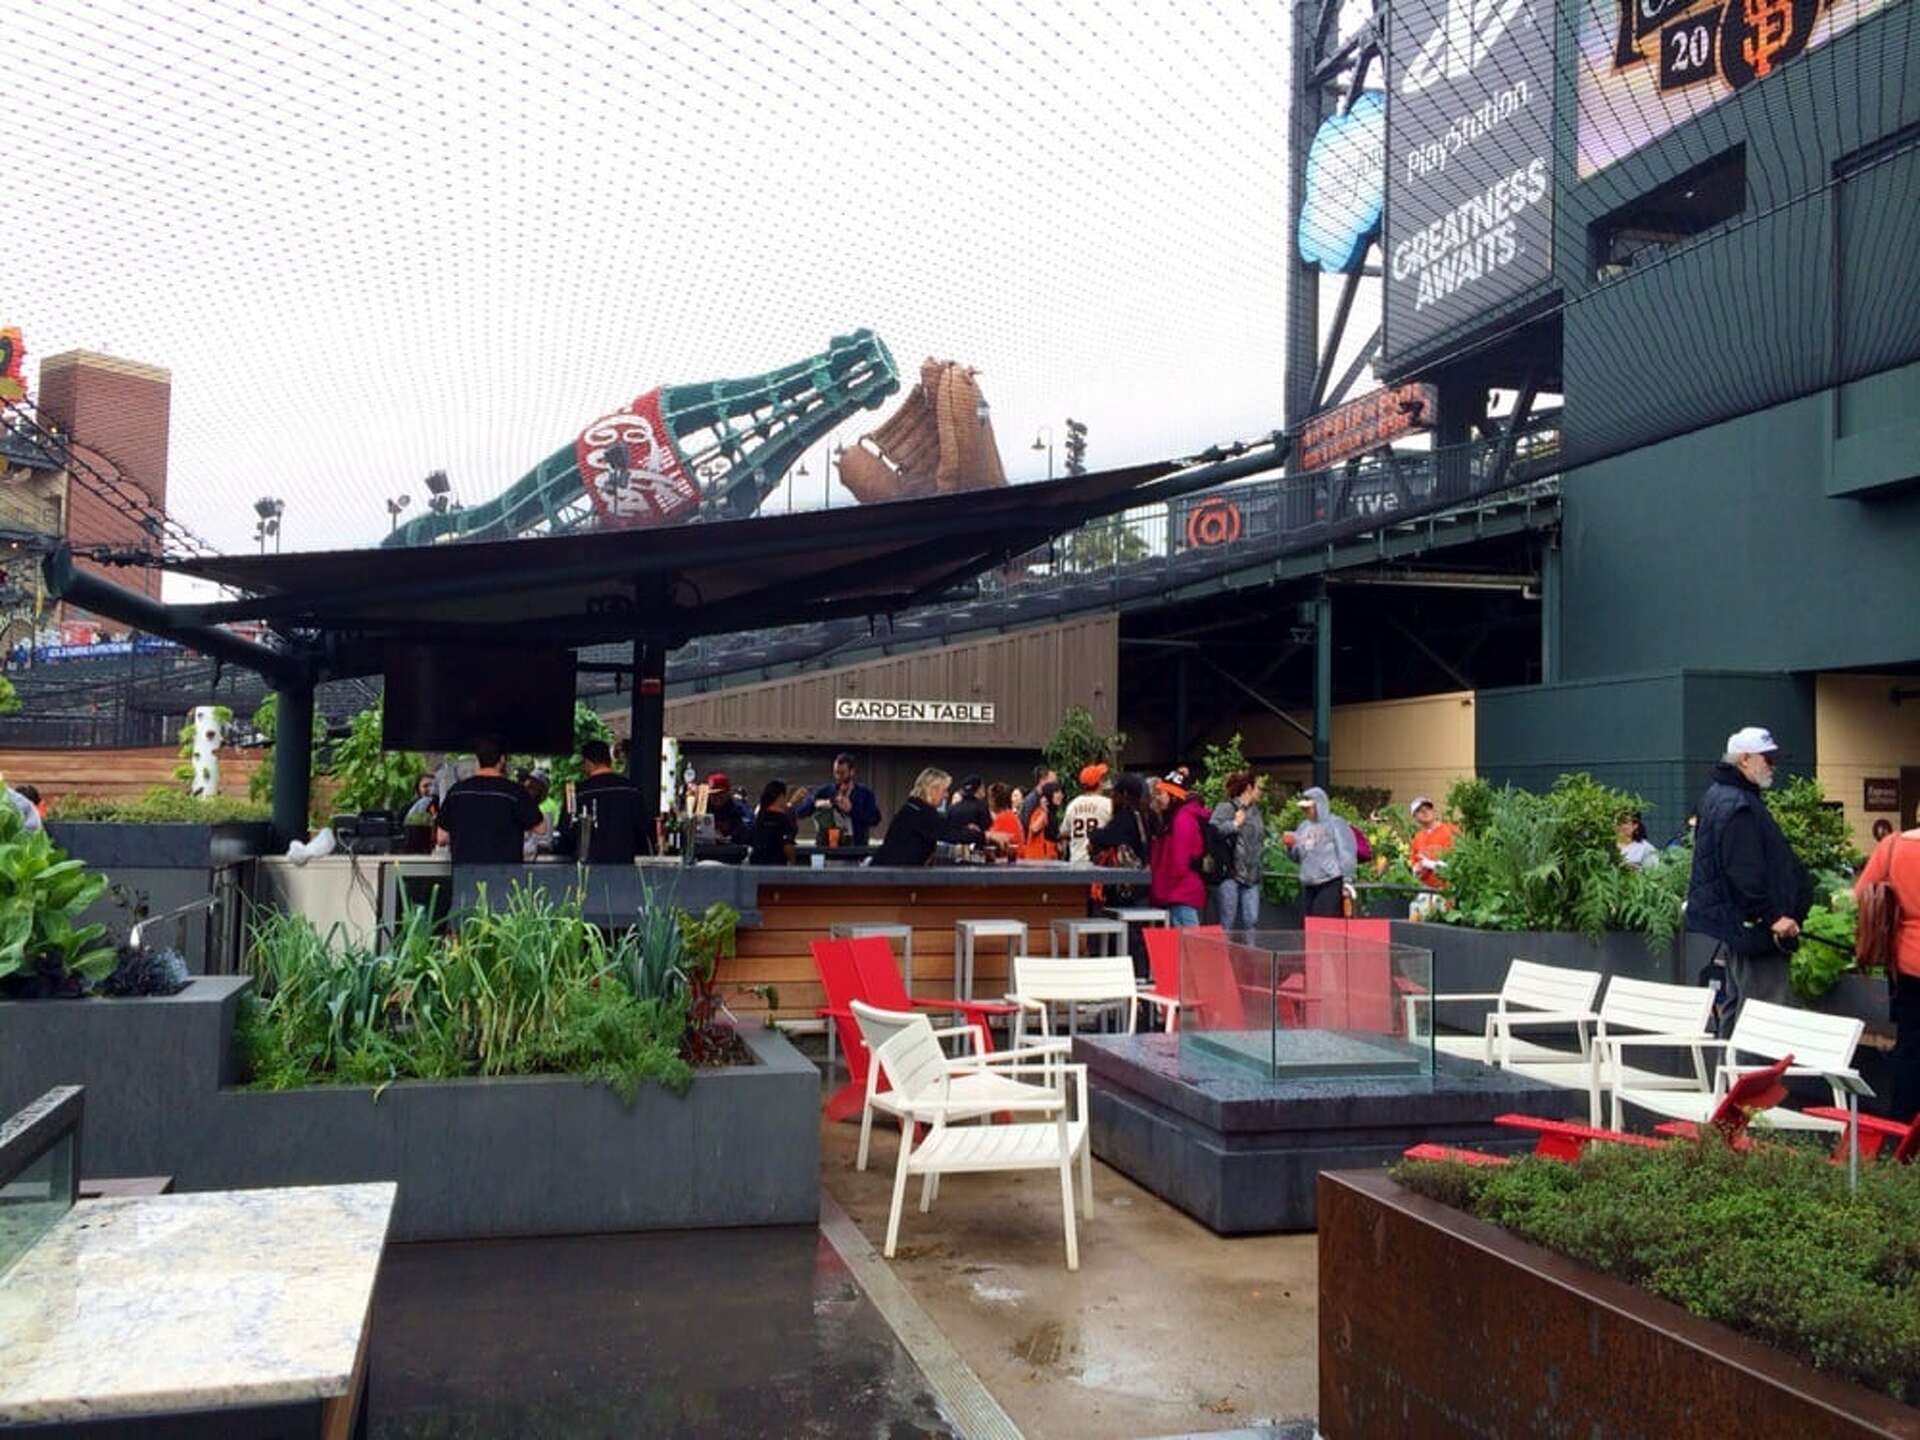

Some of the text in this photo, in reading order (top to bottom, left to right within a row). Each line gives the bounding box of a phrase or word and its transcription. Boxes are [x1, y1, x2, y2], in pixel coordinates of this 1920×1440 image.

[1671, 25, 1709, 71] 20
[1407, 80, 1528, 184] PlayStation
[1392, 156, 1547, 281] GREATNESS
[837, 700, 993, 721] GARDEN TABLE
